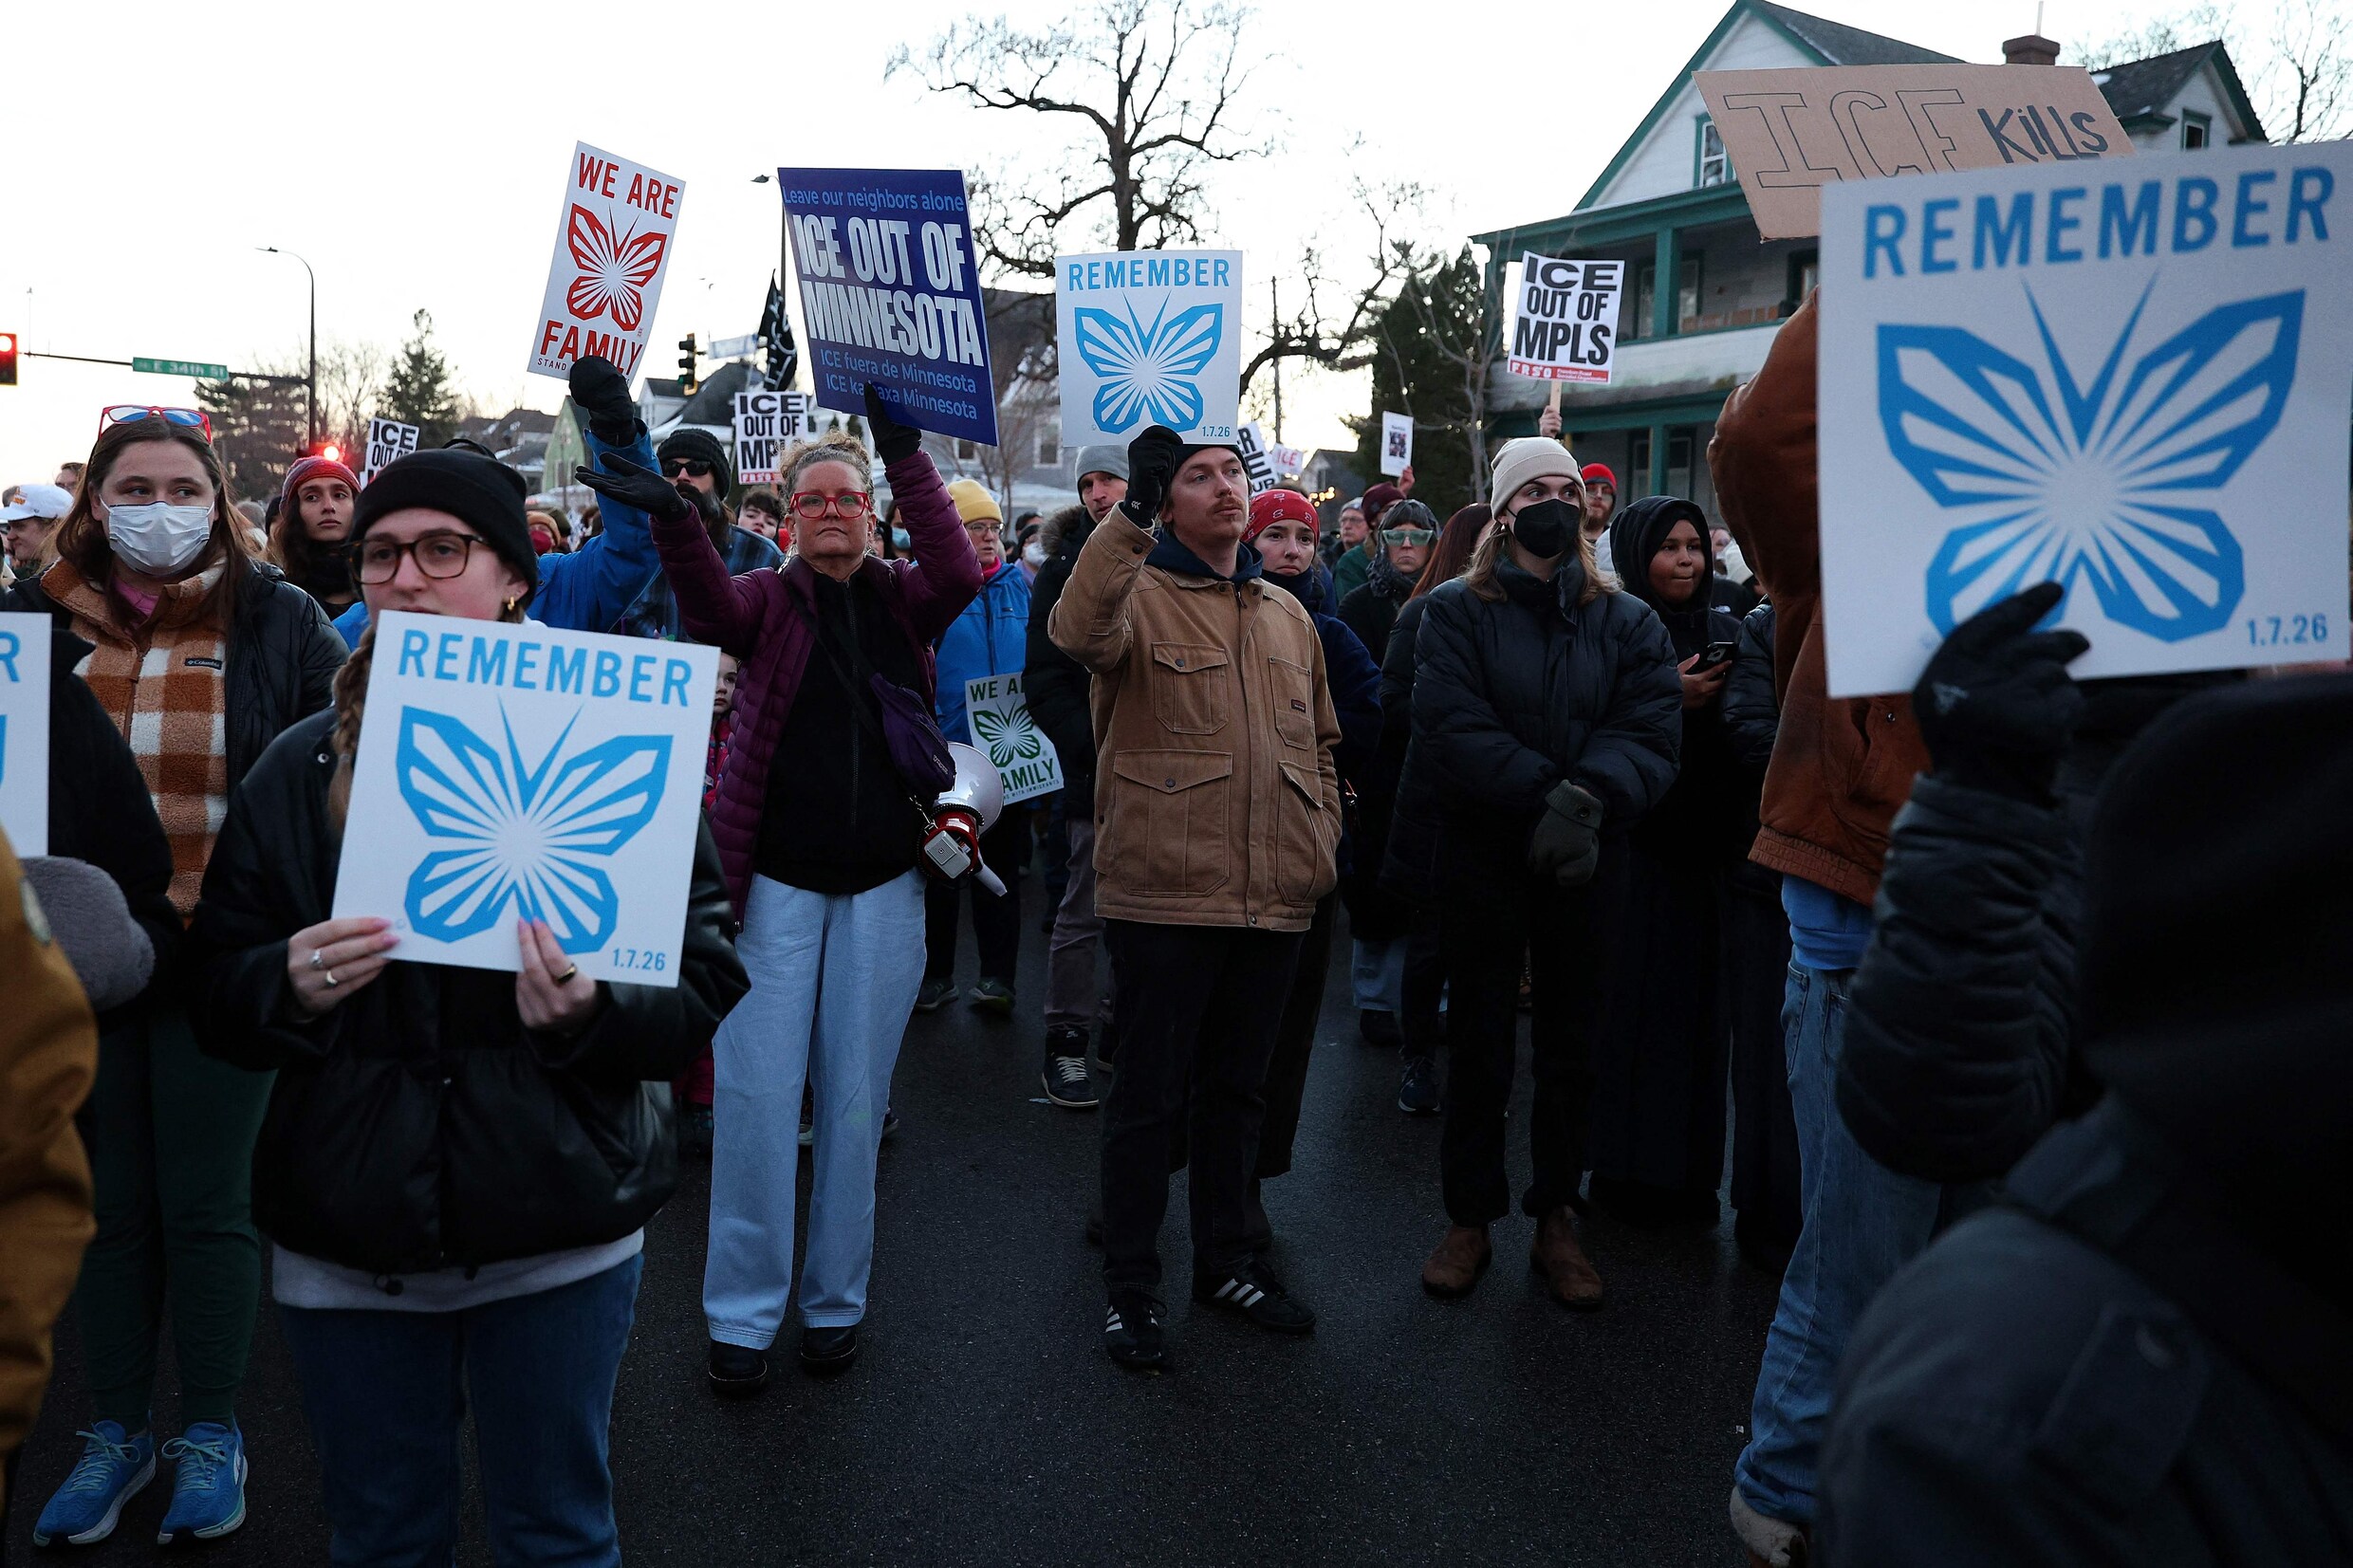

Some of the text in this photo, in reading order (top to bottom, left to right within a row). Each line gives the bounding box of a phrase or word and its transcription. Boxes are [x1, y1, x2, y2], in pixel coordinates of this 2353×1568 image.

[579, 152, 678, 219] WE ARE
[782, 186, 965, 212] Leave our neighbors alone
[1862, 166, 2336, 280] REMEMBER
[792, 213, 966, 292] ICE OUT OF
[1068, 258, 1230, 291] REMEMBER
[1526, 256, 1618, 291] ICE
[1527, 286, 1609, 322] OUT OF
[801, 280, 985, 367] MINNESOTA
[540, 320, 643, 376] FAMILY
[1513, 316, 1611, 366] MPLS
[537, 358, 567, 371] STAND
[820, 348, 976, 394] ICE fuera de Minnesota
[739, 395, 804, 415] ICE
[825, 373, 847, 393] ICE
[903, 387, 978, 420] Minnesota
[372, 421, 417, 451] ICE
[744, 415, 800, 436] OUT OF
[1201, 425, 1231, 438] 1.7.26
[371, 444, 395, 468] OUT
[1276, 449, 1298, 467] ICE
[2247, 613, 2328, 647] 1.7.26
[398, 629, 693, 708] REMEMBER
[970, 680, 998, 702] WE
[1001, 758, 1054, 794] AMILY
[612, 948, 666, 972] 1.7.26
